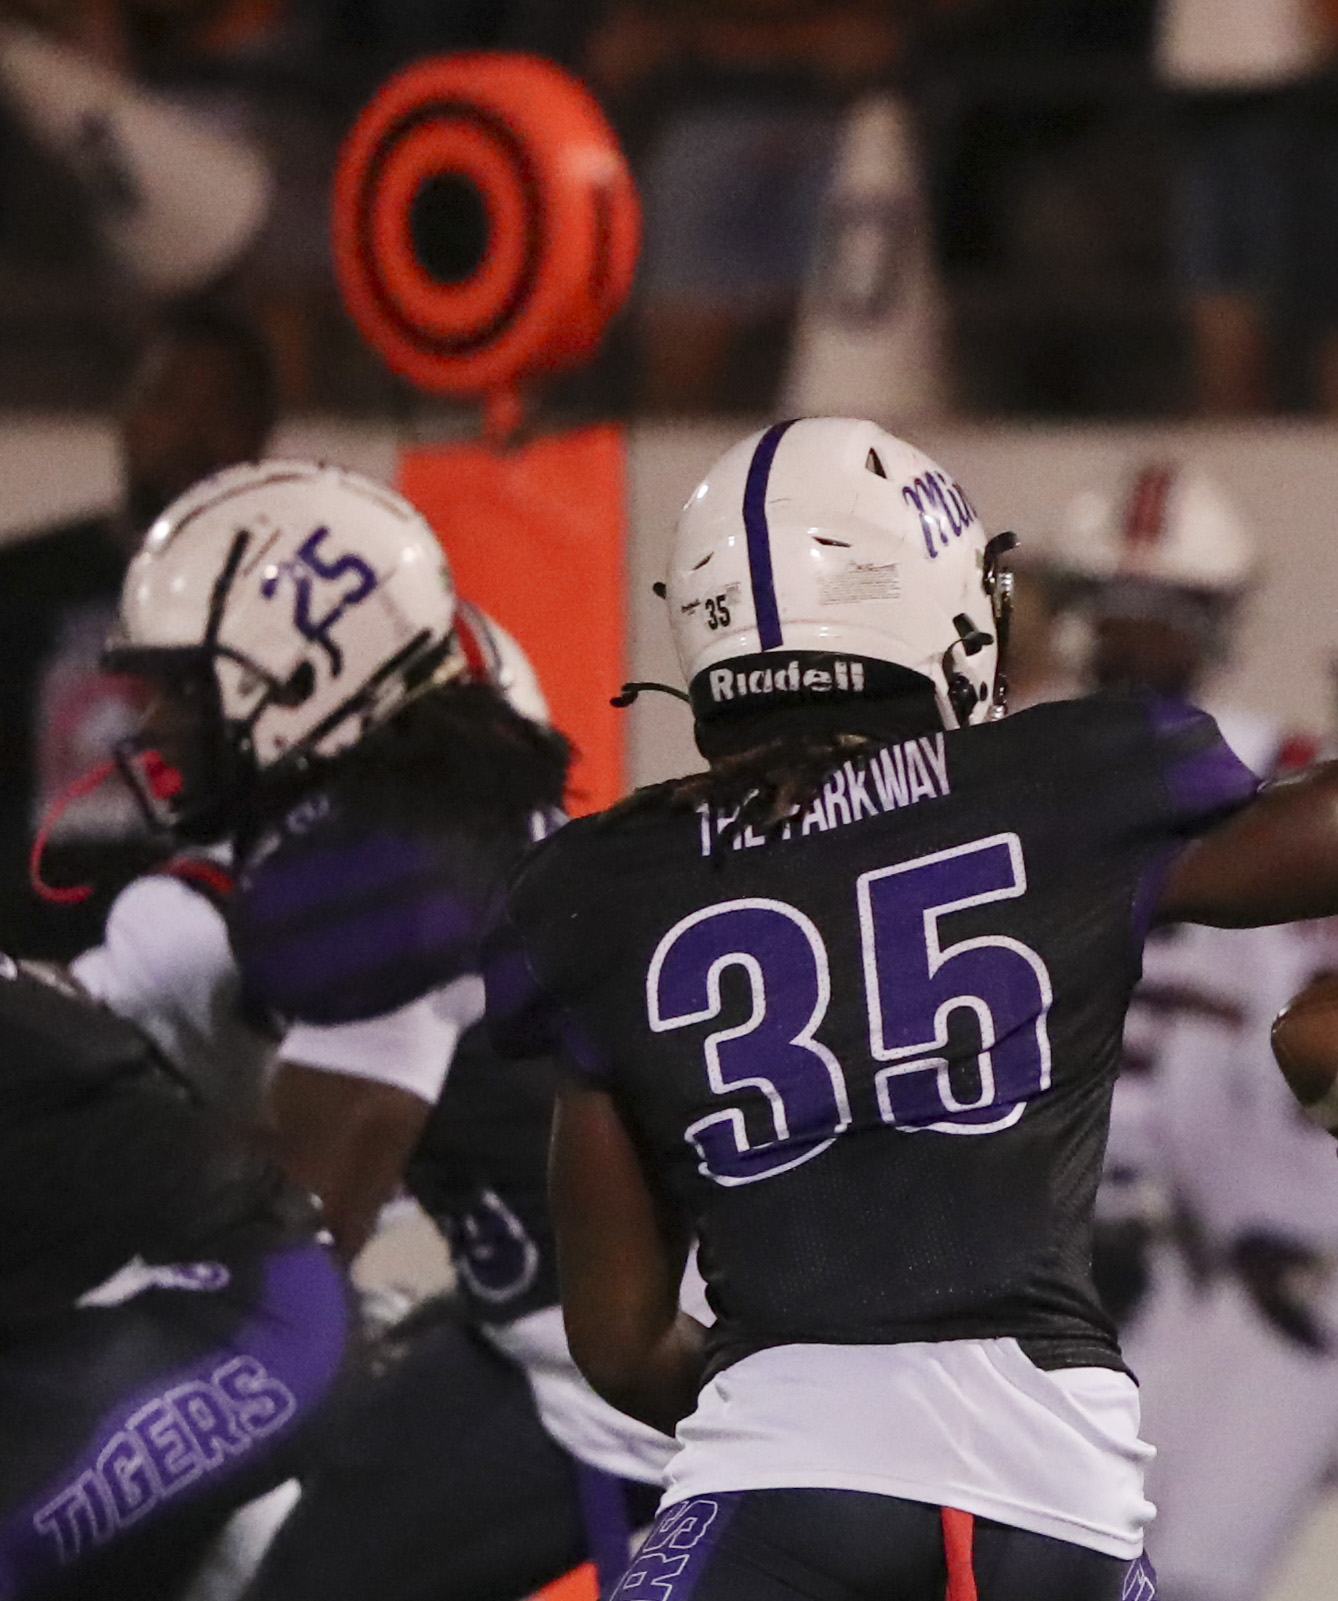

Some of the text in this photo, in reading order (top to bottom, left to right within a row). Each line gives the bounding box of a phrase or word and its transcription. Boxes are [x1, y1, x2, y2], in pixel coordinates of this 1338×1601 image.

[261, 526, 378, 640] 25
[704, 594, 732, 631] 35
[781, 732, 950, 841] ARKWAY
[646, 832, 1053, 1187] 35
[33, 1354, 297, 1563] TIGERS
